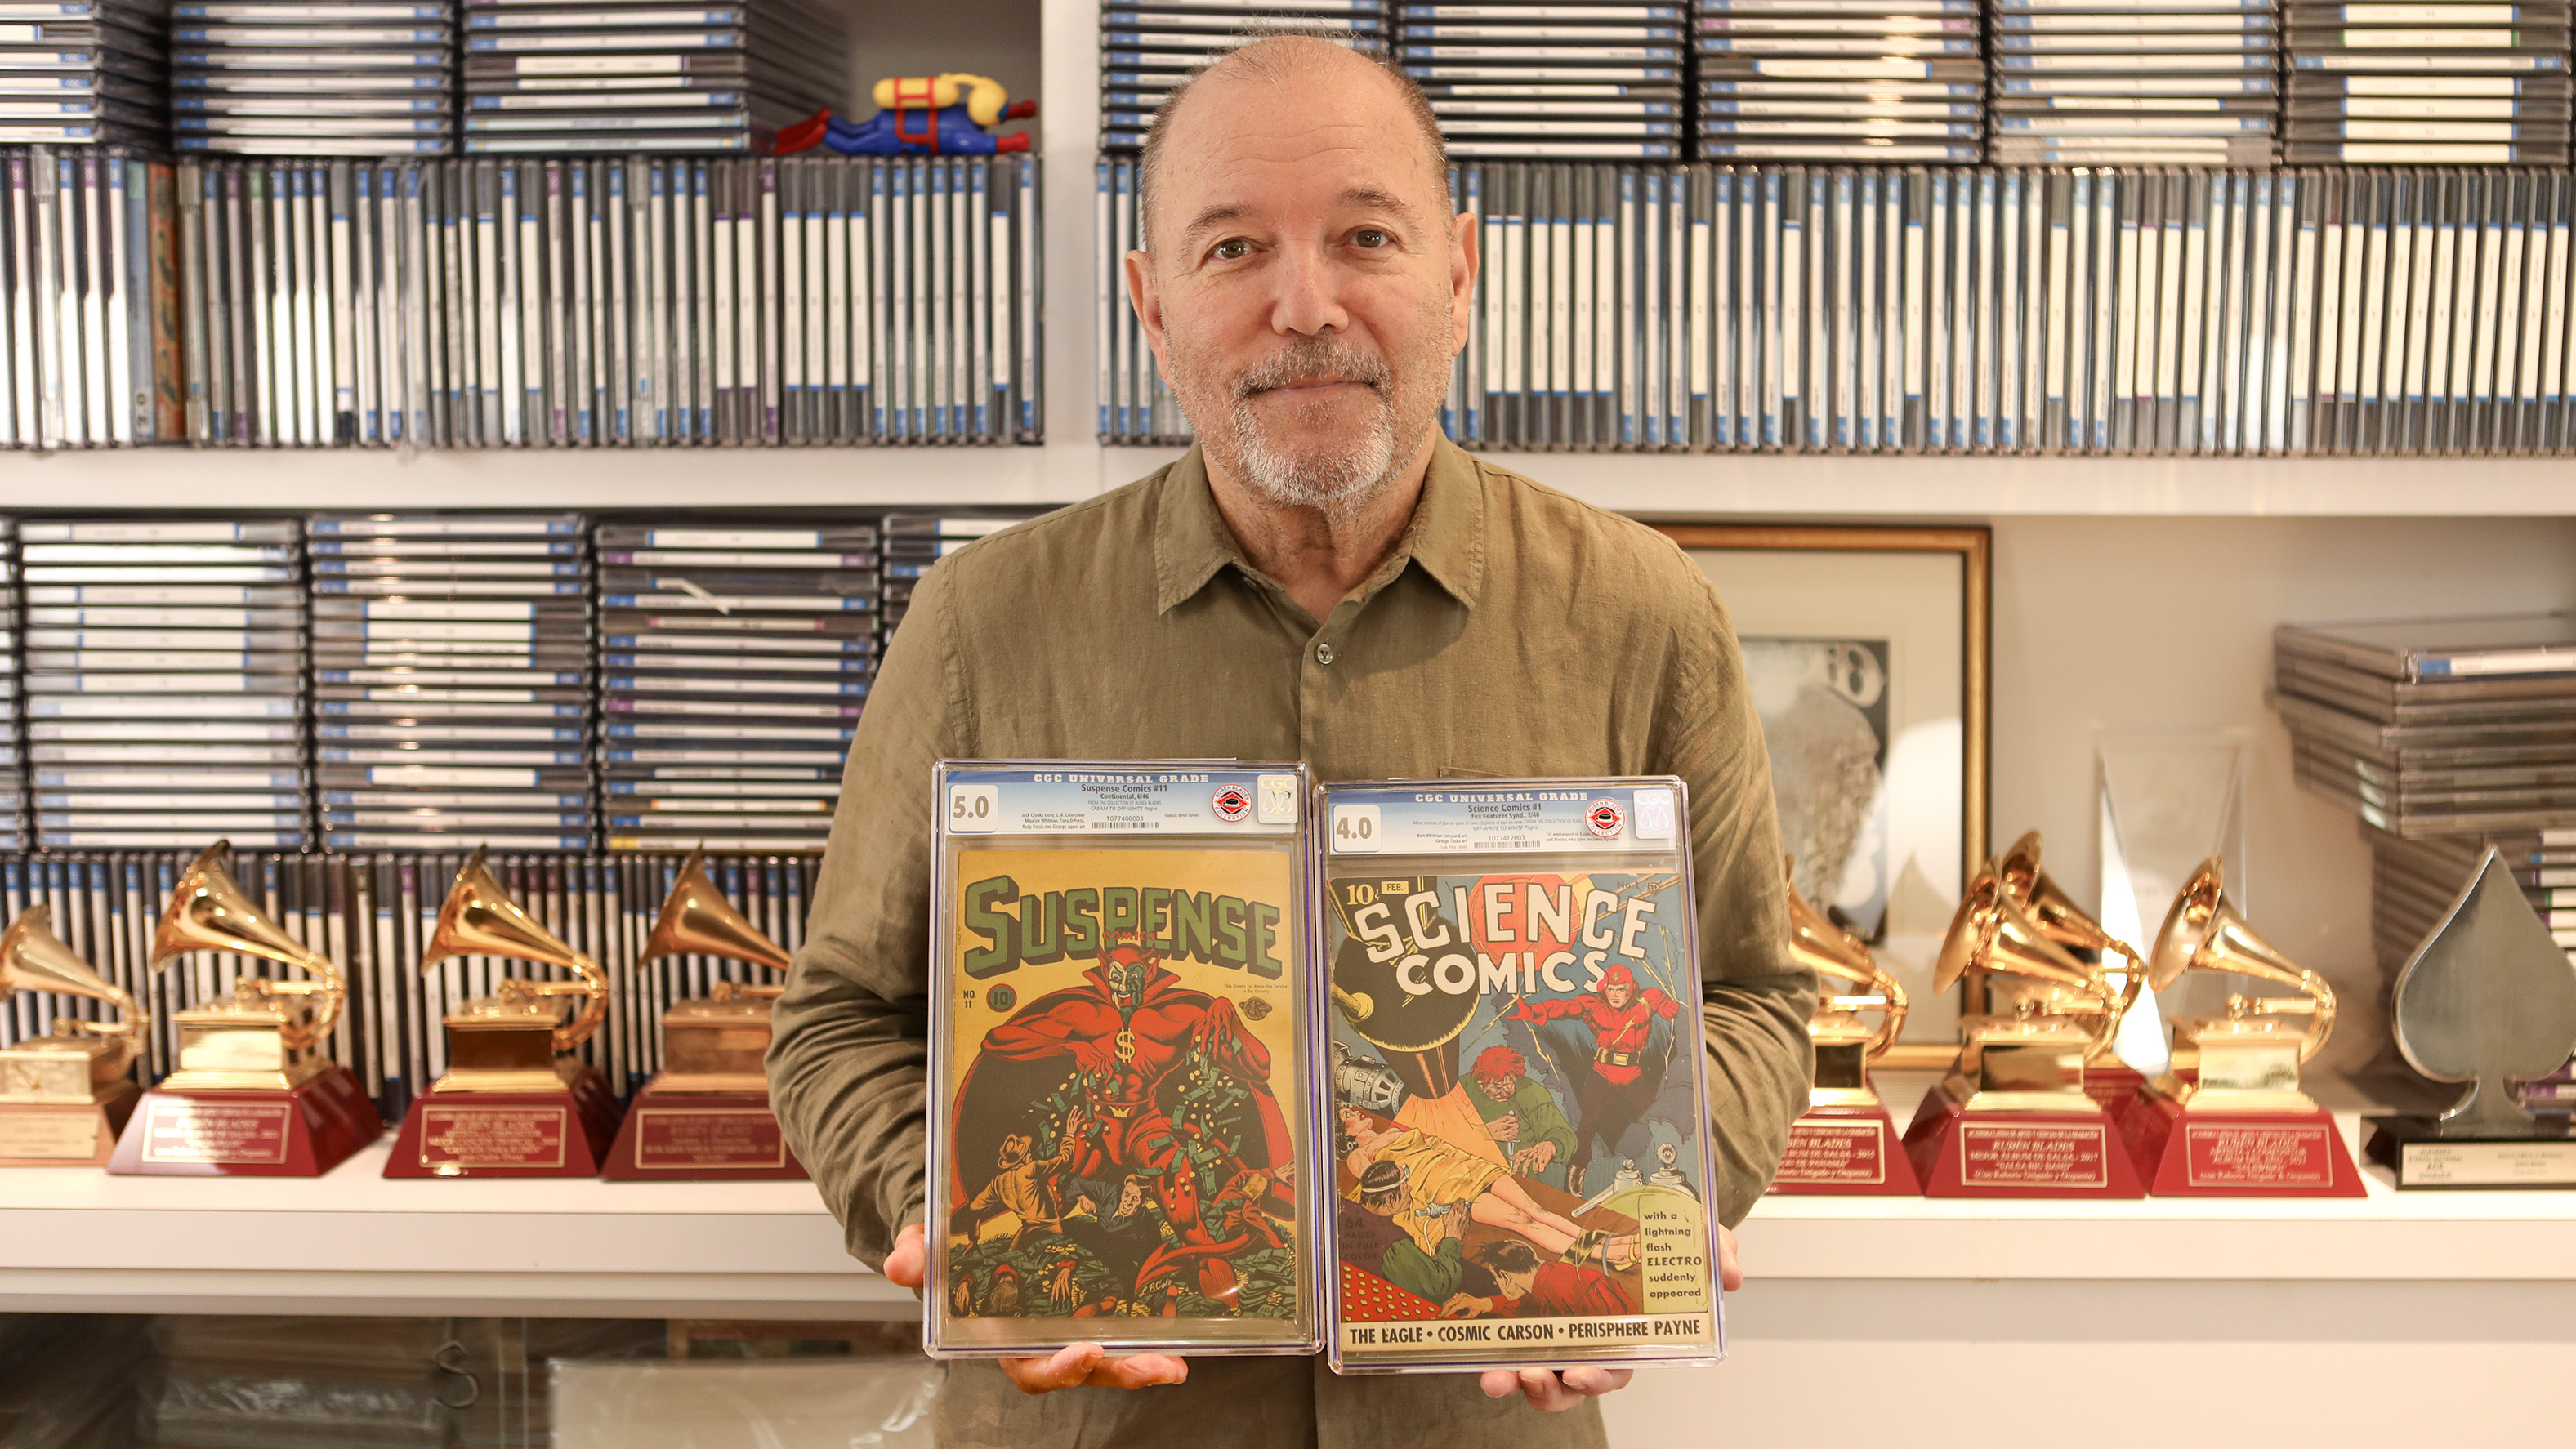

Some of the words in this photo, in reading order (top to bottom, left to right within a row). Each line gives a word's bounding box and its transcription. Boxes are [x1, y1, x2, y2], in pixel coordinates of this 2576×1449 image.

[1034, 774, 1062, 782] CGC
[1069, 774, 1153, 782] UNIVERSAL
[1159, 774, 1208, 782] GRADE
[1261, 778, 1294, 789] CGC
[1082, 784, 1120, 794] Suspense
[1123, 784, 1151, 792] Comics
[1154, 784, 1167, 792] #11
[1216, 786, 1231, 797] RUBEN
[1232, 786, 1250, 800] BLADES
[1415, 794, 1443, 803] CGC
[1449, 792, 1533, 803] UNIVERSAL
[1539, 792, 1588, 800] GRADE
[1636, 795, 1671, 805] CGC
[953, 796, 989, 818] 5.0
[1467, 805, 1498, 813] Science
[1502, 804, 1531, 812] Comics
[1588, 802, 1604, 814] RUBEN
[1605, 801, 1623, 815] BLADES
[1214, 806, 1248, 820] COLLECTION
[1337, 817, 1373, 840] 4.0
[1588, 822, 1622, 835] COLLECTION
[1346, 884, 1380, 905] 10¢
[964, 874, 1283, 980] SUSPENSE
[1354, 883, 1658, 964] SCIENCE
[1102, 930, 1156, 941] COMICS
[1395, 950, 1609, 996] COMICS
[1644, 1211, 1667, 1220] with
[1645, 1227, 1691, 1237] lightning
[1646, 1243, 1672, 1251] flash
[1647, 1256, 1702, 1266] ELECTRO
[1649, 1273, 1696, 1282] suddenly
[1650, 1288, 1701, 1299] appeared
[1350, 1327, 1376, 1344] THE
[1382, 1326, 1423, 1344] EAGLE
[1438, 1325, 1492, 1341] COSMIC
[1497, 1323, 1554, 1340] CARSON
[1569, 1321, 1649, 1338] PERISPHERE
[1654, 1319, 1701, 1336] PAYNE
